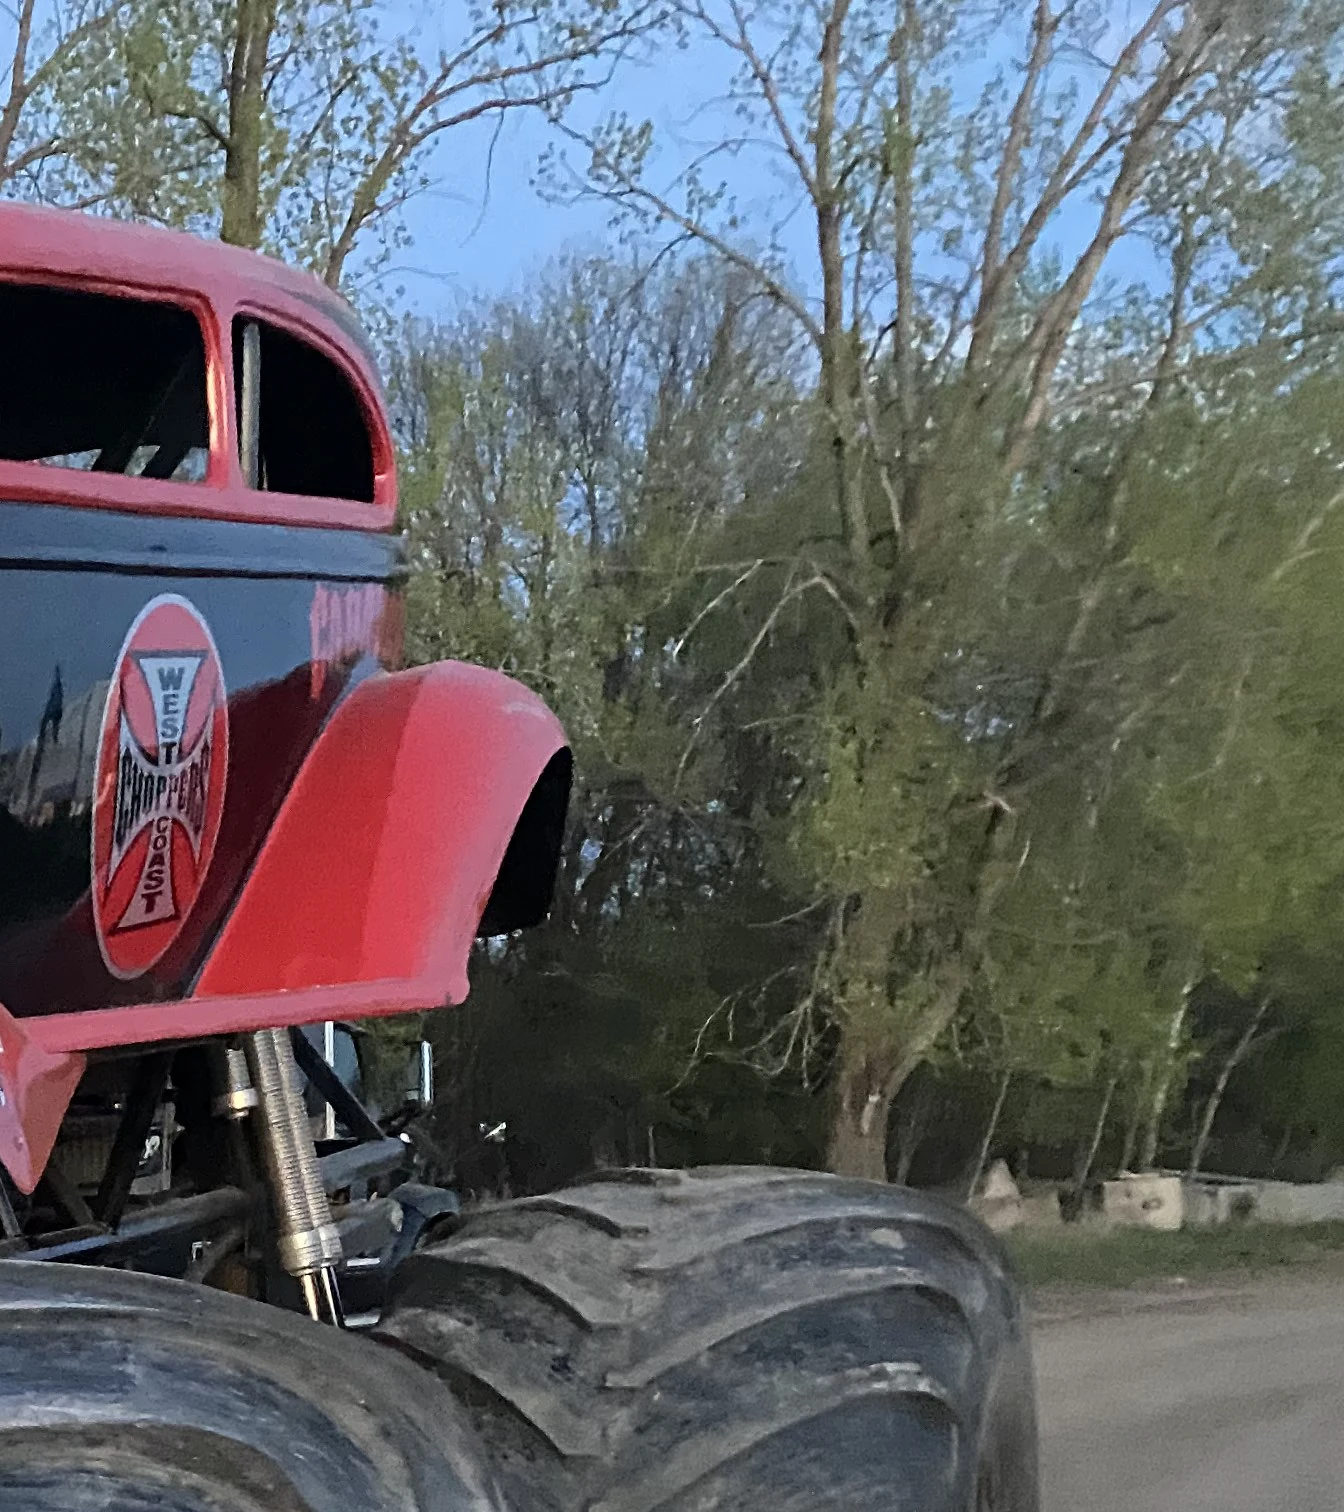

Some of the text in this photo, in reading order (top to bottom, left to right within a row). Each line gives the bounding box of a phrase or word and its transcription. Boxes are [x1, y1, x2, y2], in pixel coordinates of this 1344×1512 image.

[157, 666, 185, 765] WEST
[116, 742, 210, 852] CHOPPERS
[141, 815, 170, 914] COAST
